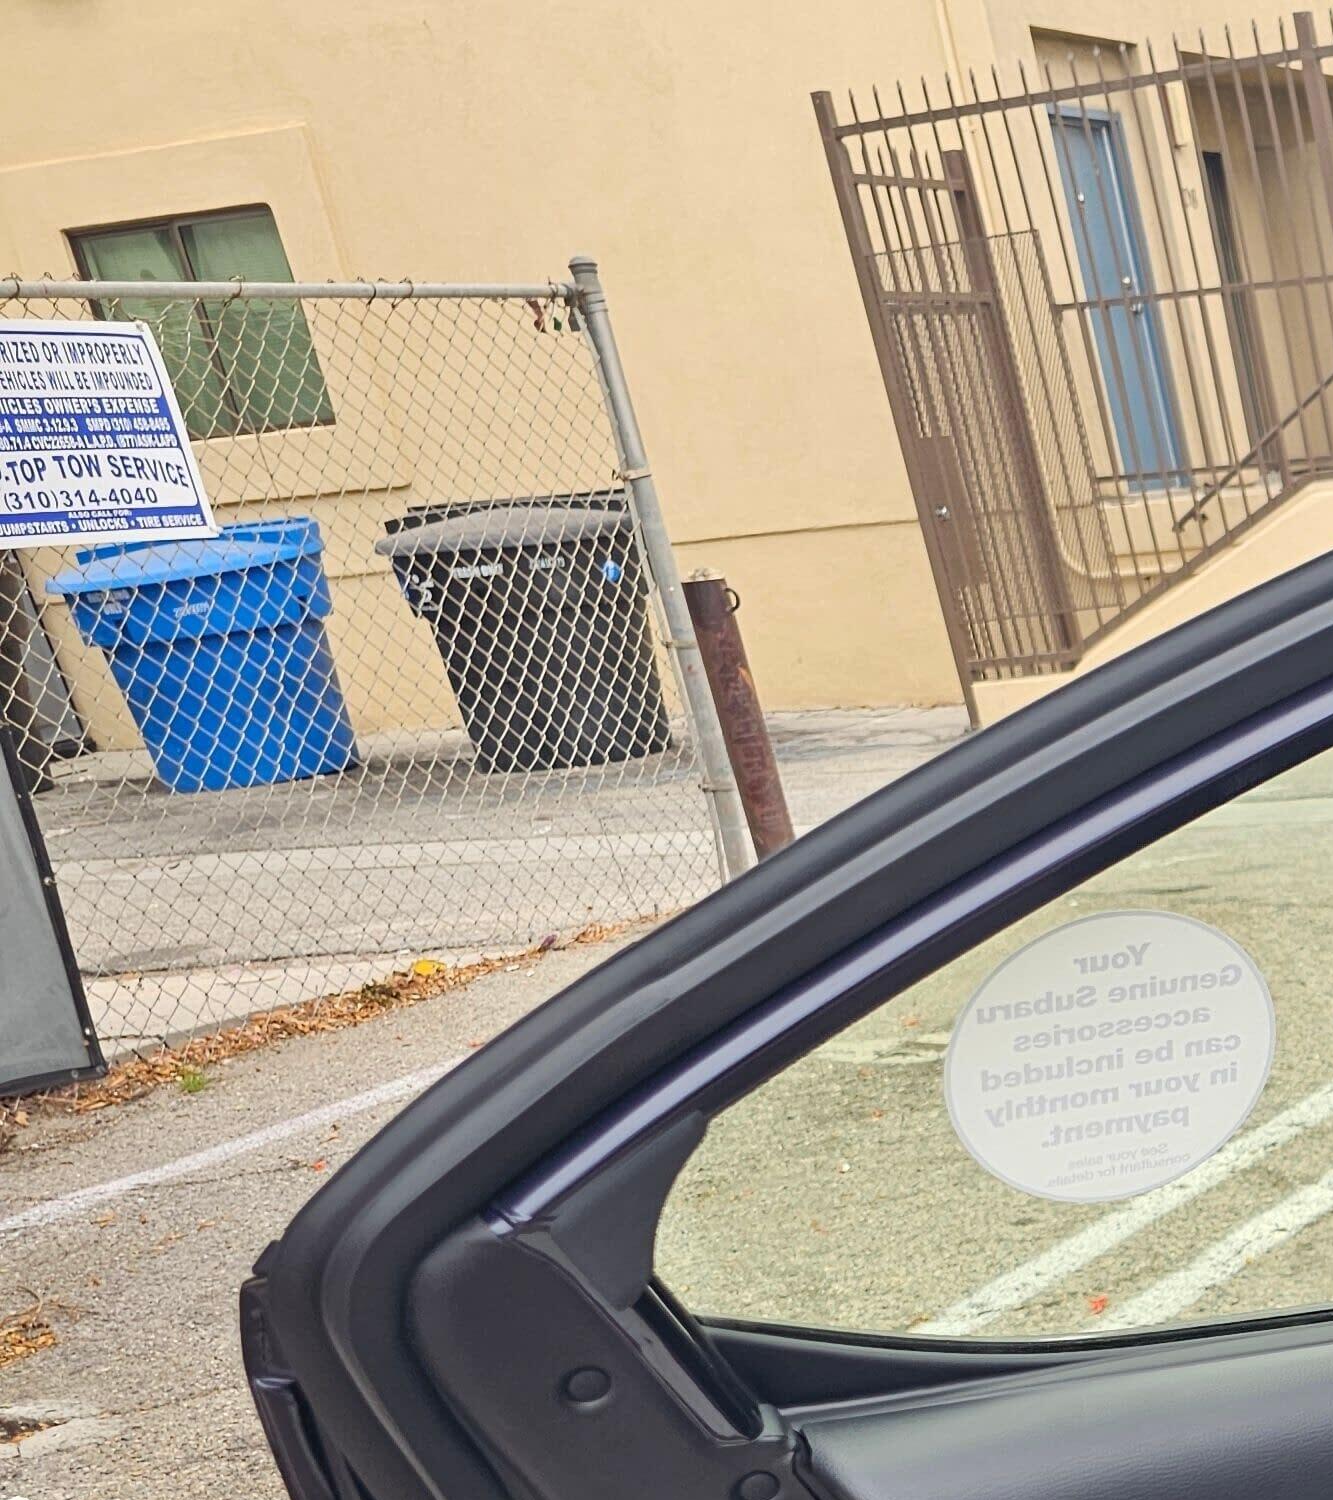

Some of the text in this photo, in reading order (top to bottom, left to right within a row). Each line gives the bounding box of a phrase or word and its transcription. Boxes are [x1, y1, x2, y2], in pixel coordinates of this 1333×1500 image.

[41, 341, 63, 364] OR
[61, 341, 144, 365] IMPROPERLY
[46, 370, 75, 390] WILL
[74, 371, 91, 390] BE
[90, 371, 153, 391] IMPOUNDED
[44, 398, 101, 414] OWNER'S
[102, 398, 160, 414] EXPENSE
[15, 418, 42, 433] SMMC
[52, 454, 102, 479] TOW
[107, 455, 189, 487] SERVICE
[79, 518, 129, 532] UNLOCKS
[138, 516, 162, 529] TIRE
[163, 514, 203, 527] SERVICE
